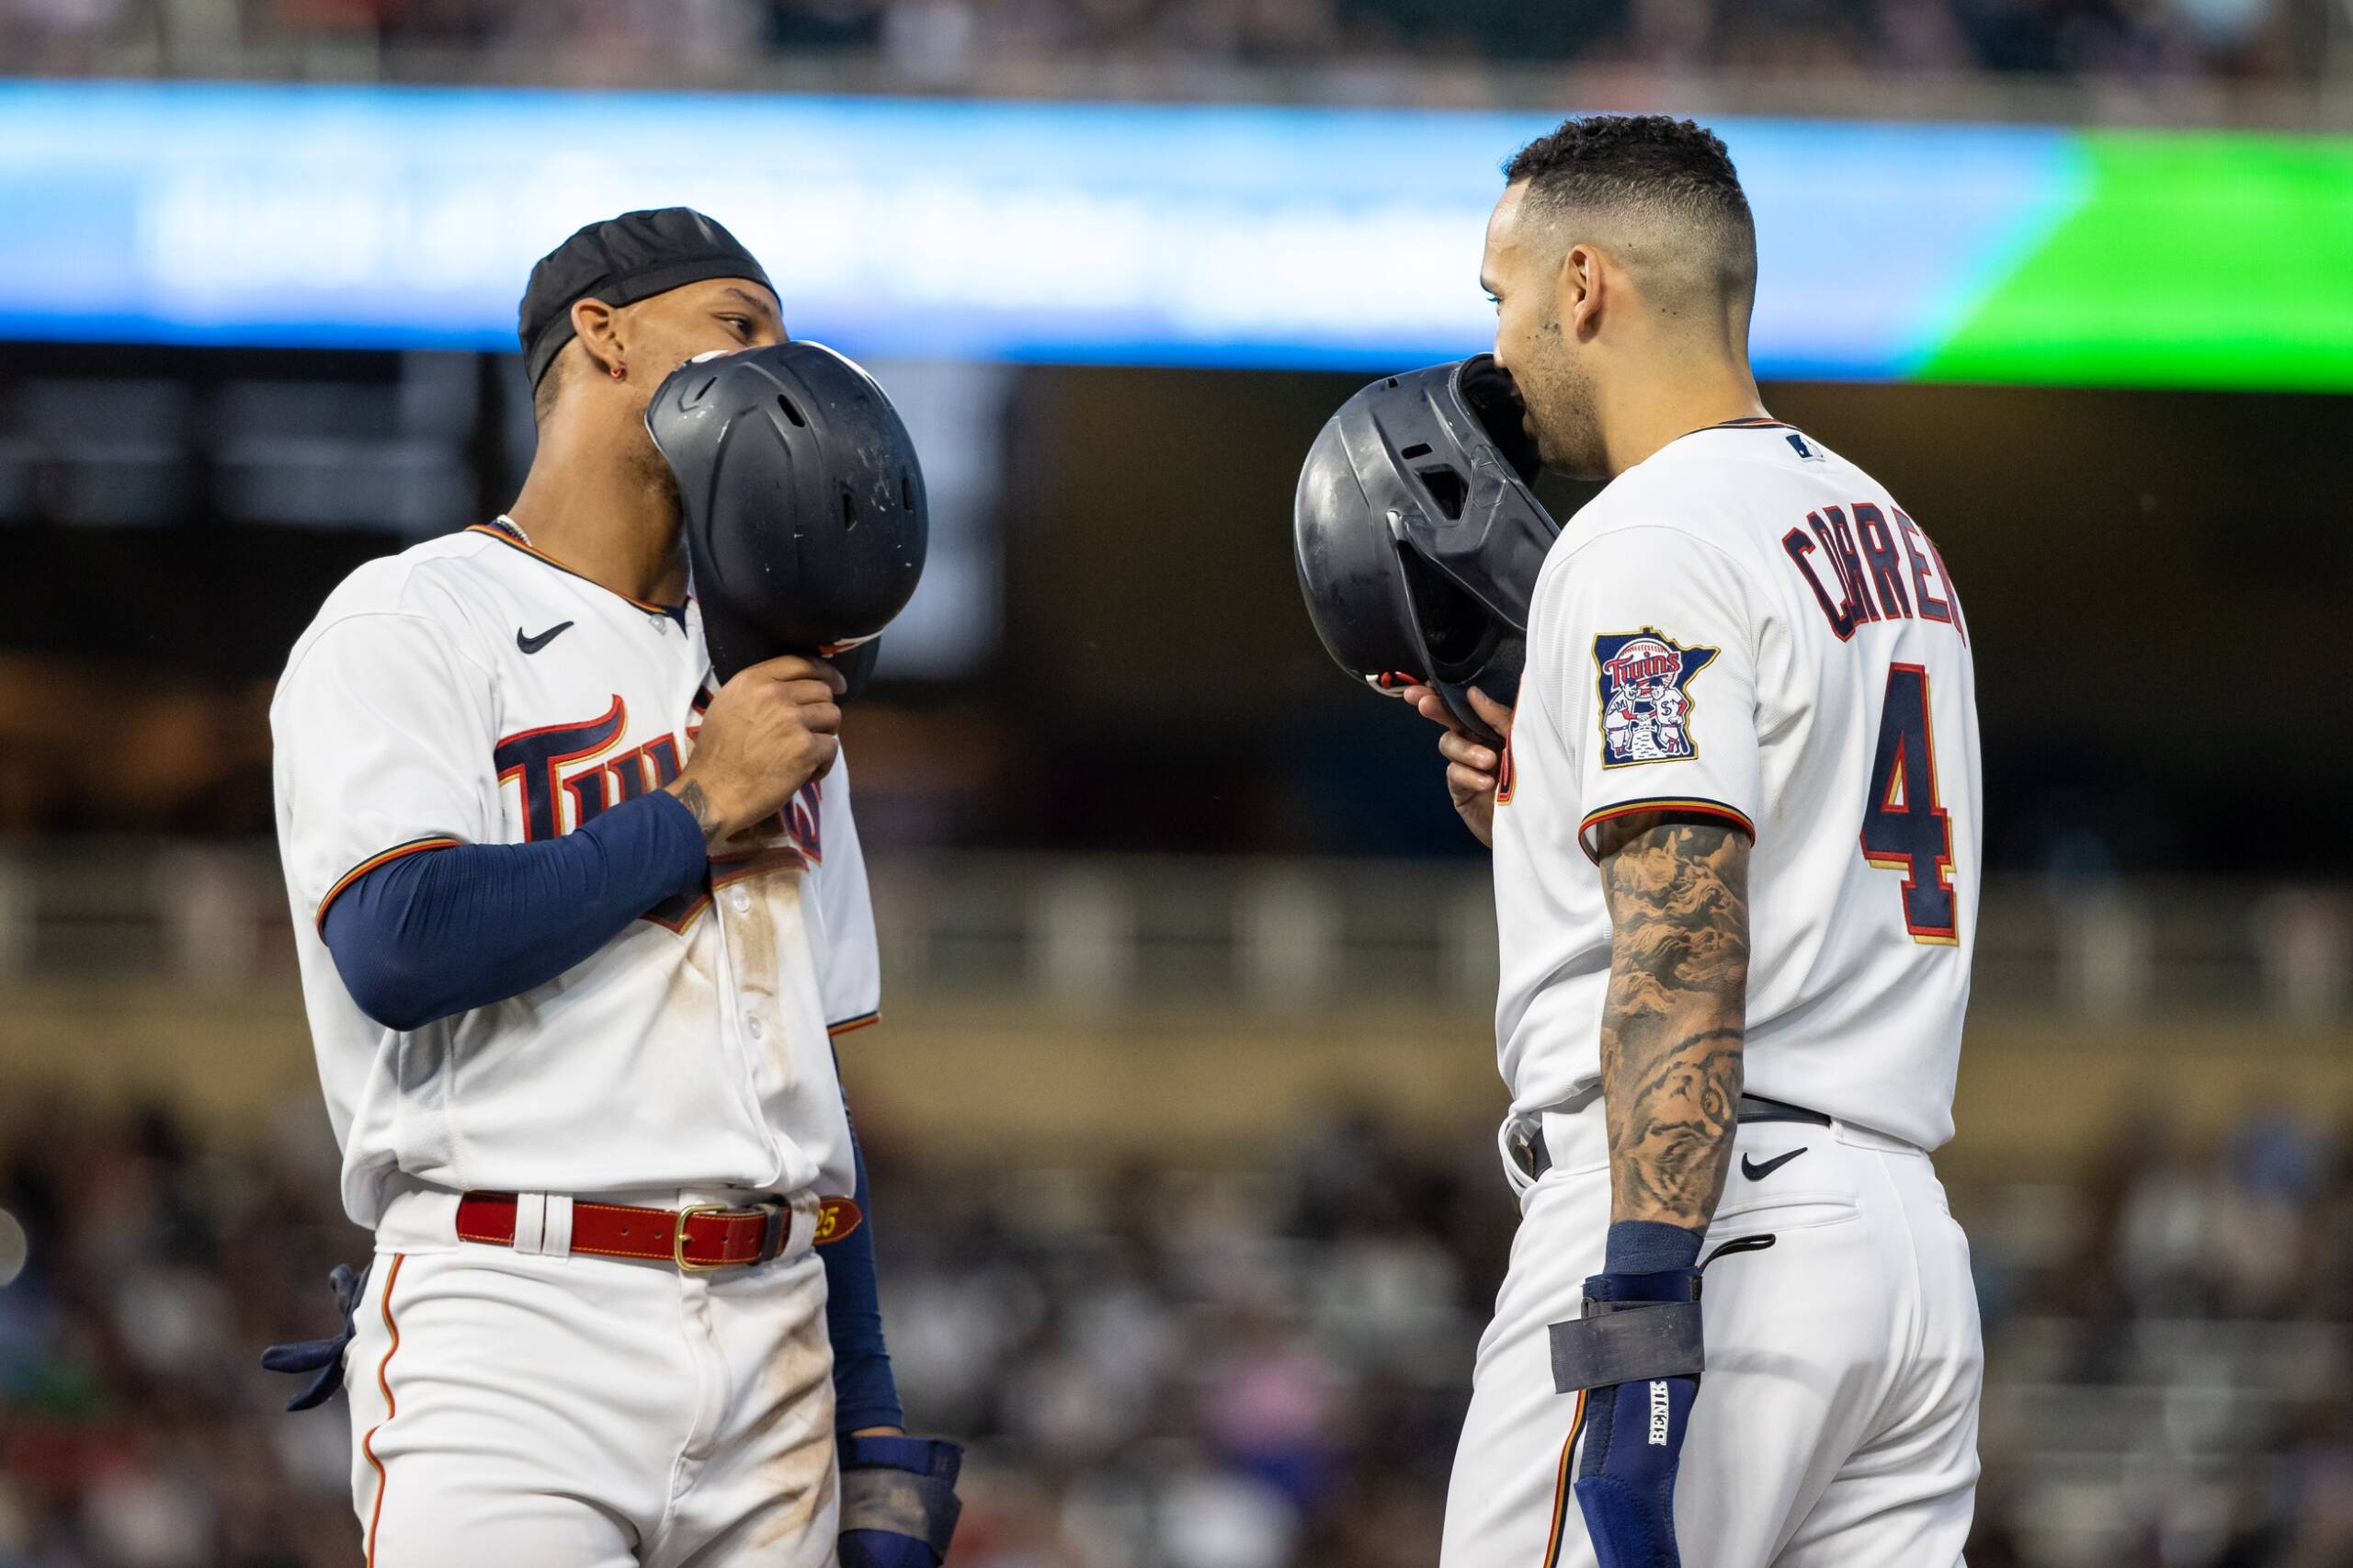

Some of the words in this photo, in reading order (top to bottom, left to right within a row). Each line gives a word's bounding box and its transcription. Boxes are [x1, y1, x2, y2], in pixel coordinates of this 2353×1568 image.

[1782, 503, 1965, 647] CORRE
[1605, 651, 1680, 689] Twins
[1859, 662, 1960, 947] 4
[1649, 1381, 1668, 1446] BENIK
